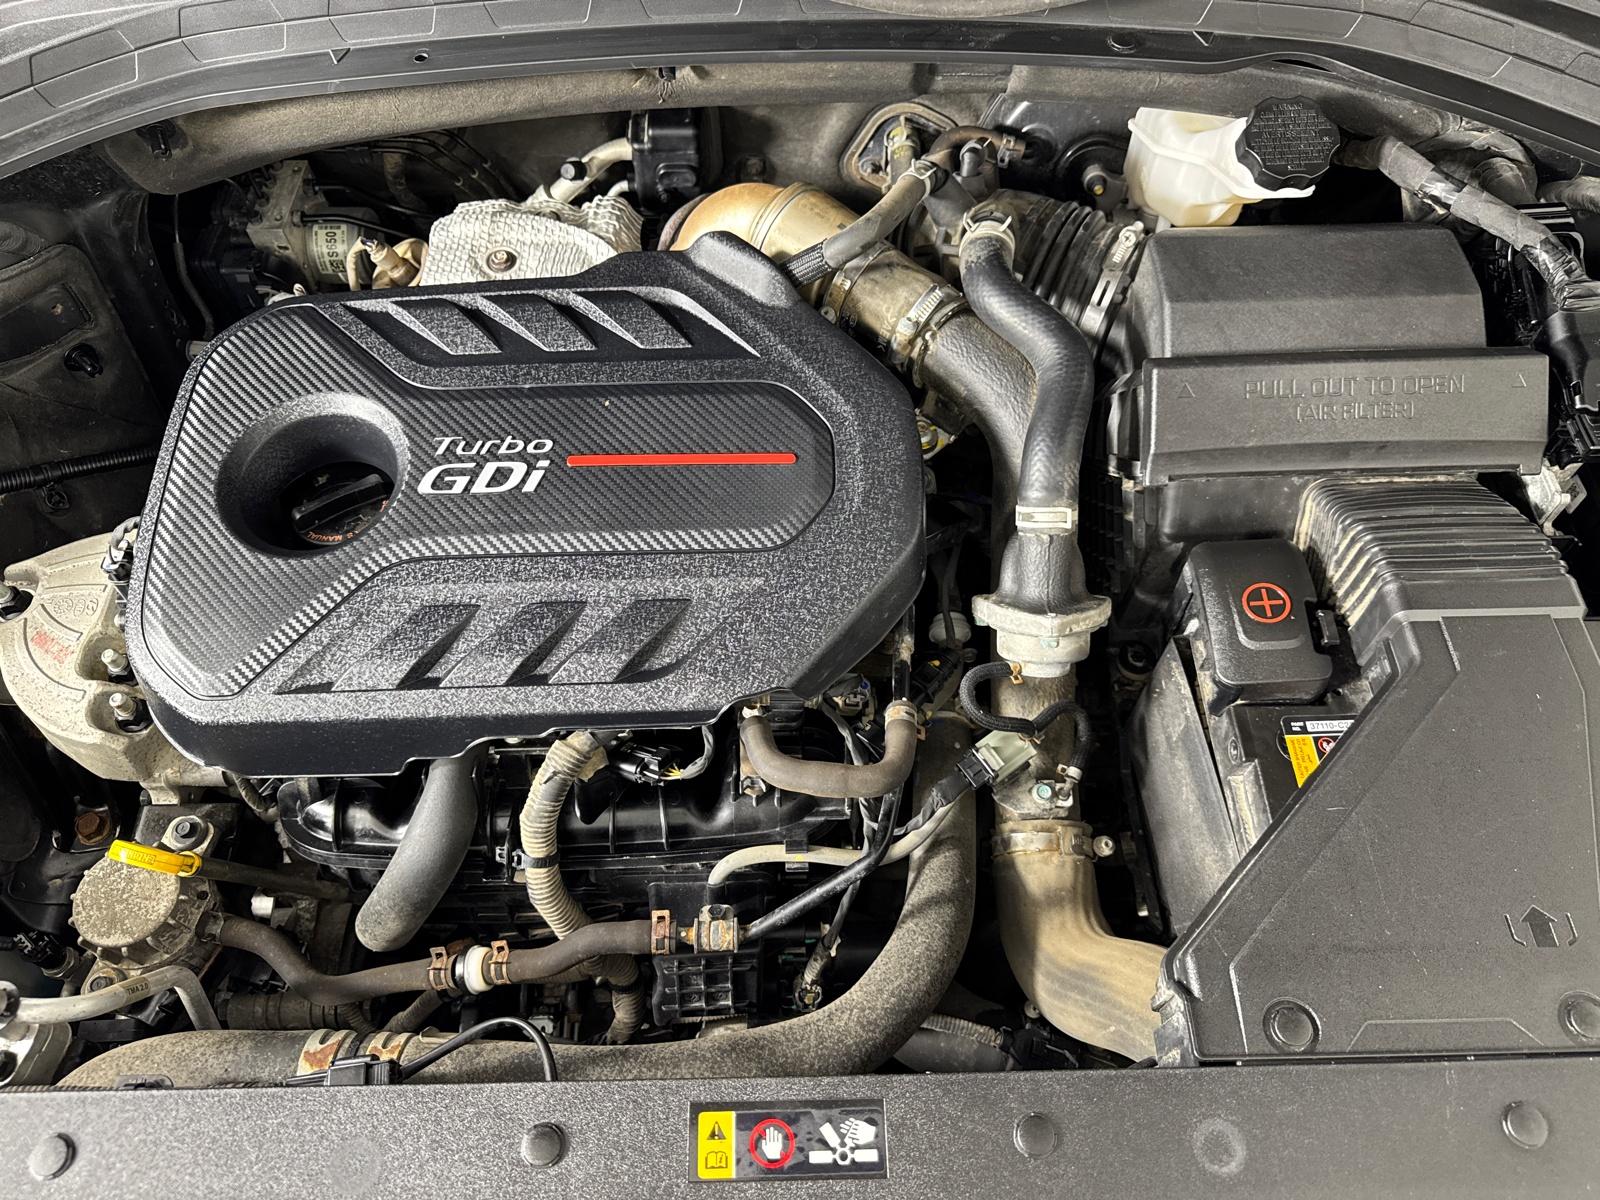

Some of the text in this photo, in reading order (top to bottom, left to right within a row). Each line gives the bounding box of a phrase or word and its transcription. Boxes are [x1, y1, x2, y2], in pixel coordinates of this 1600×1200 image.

[325, 231, 339, 258] S650
[1244, 374, 1465, 399] PULL OUT TO OPEN
[433, 435, 554, 457] Turbo
[417, 460, 551, 495] GDi
[307, 531, 343, 542] MANUAL
[1310, 720, 1352, 730] 37110-C2
